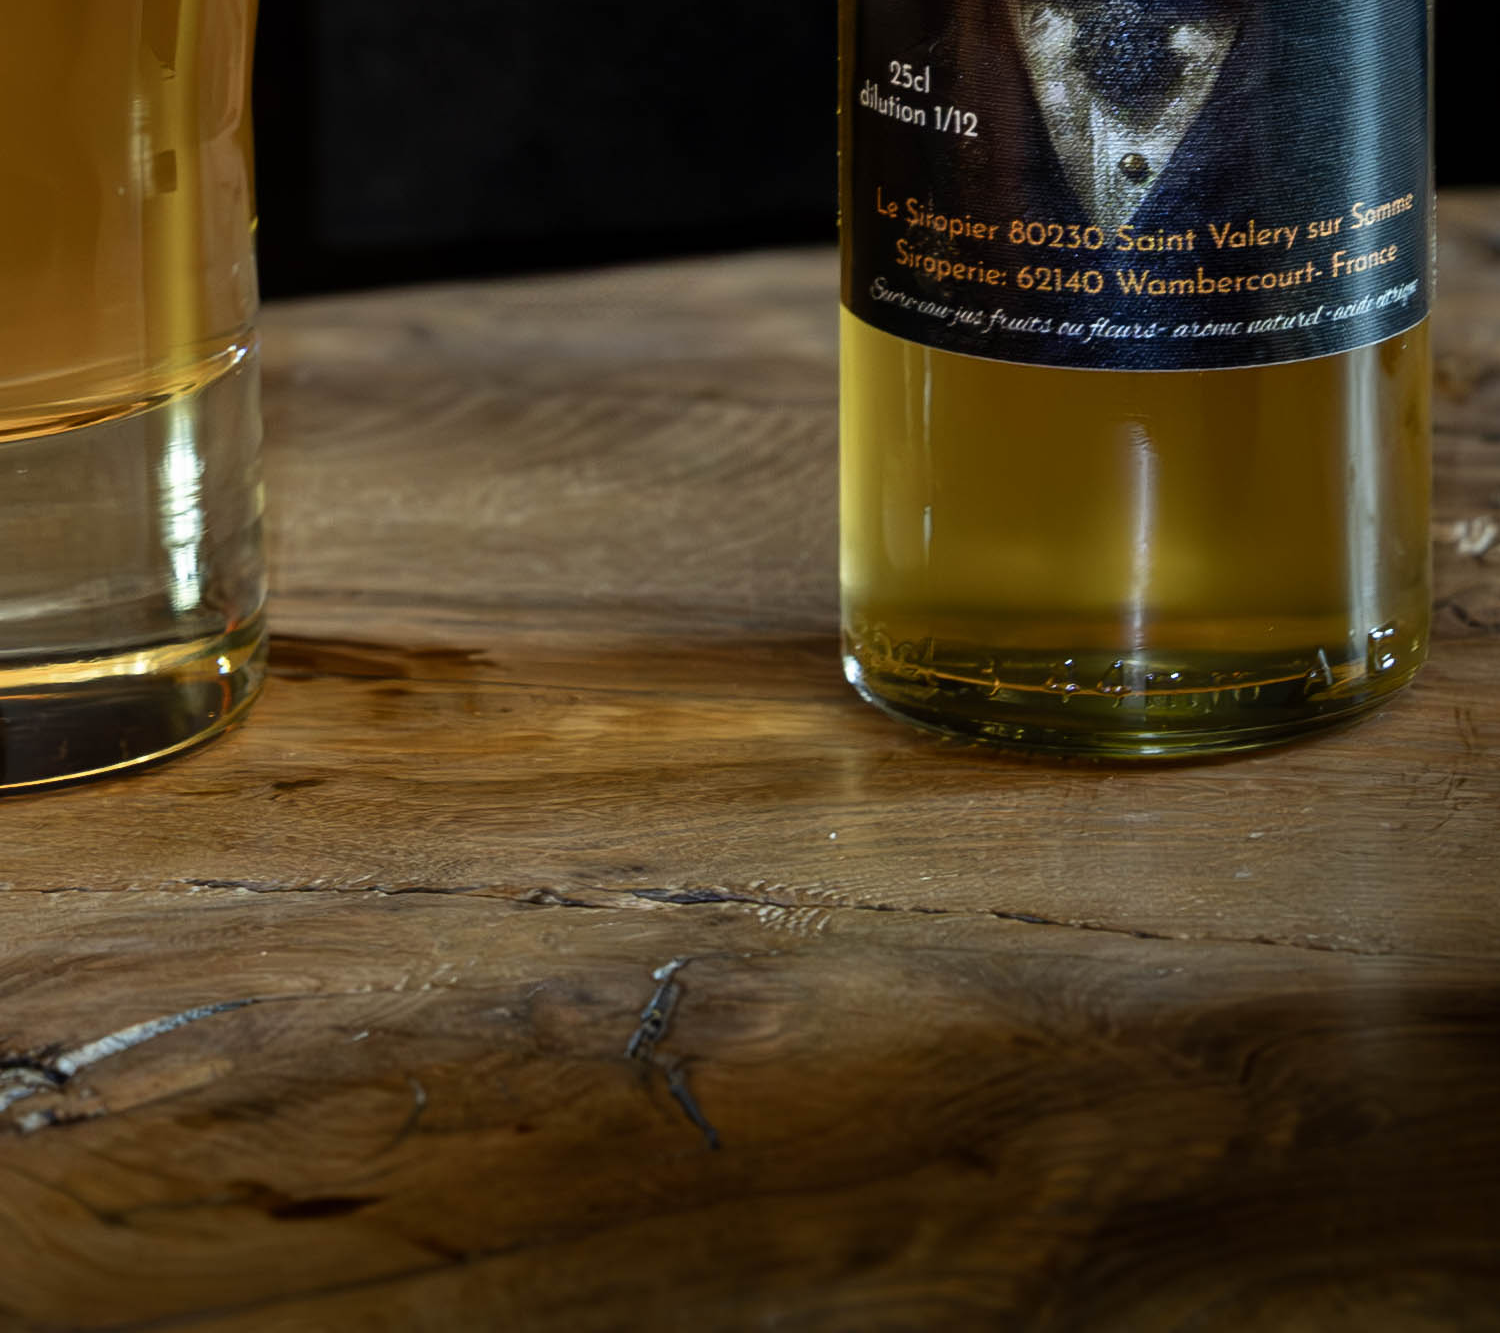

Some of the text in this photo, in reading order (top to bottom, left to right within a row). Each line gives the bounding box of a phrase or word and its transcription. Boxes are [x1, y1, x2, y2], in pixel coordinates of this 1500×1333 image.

[889, 60, 930, 94] 25cl
[860, 78, 979, 137] dilution 1/12
[876, 186, 1415, 252] Le Siropier 80230 Saint Valery sur Somme
[895, 237, 1007, 286] Siroperie:
[1016, 264, 1105, 295] 62140
[1331, 244, 1399, 278] France
[981, 308, 1054, 334] fruits
[1057, 321, 1086, 337] ou
